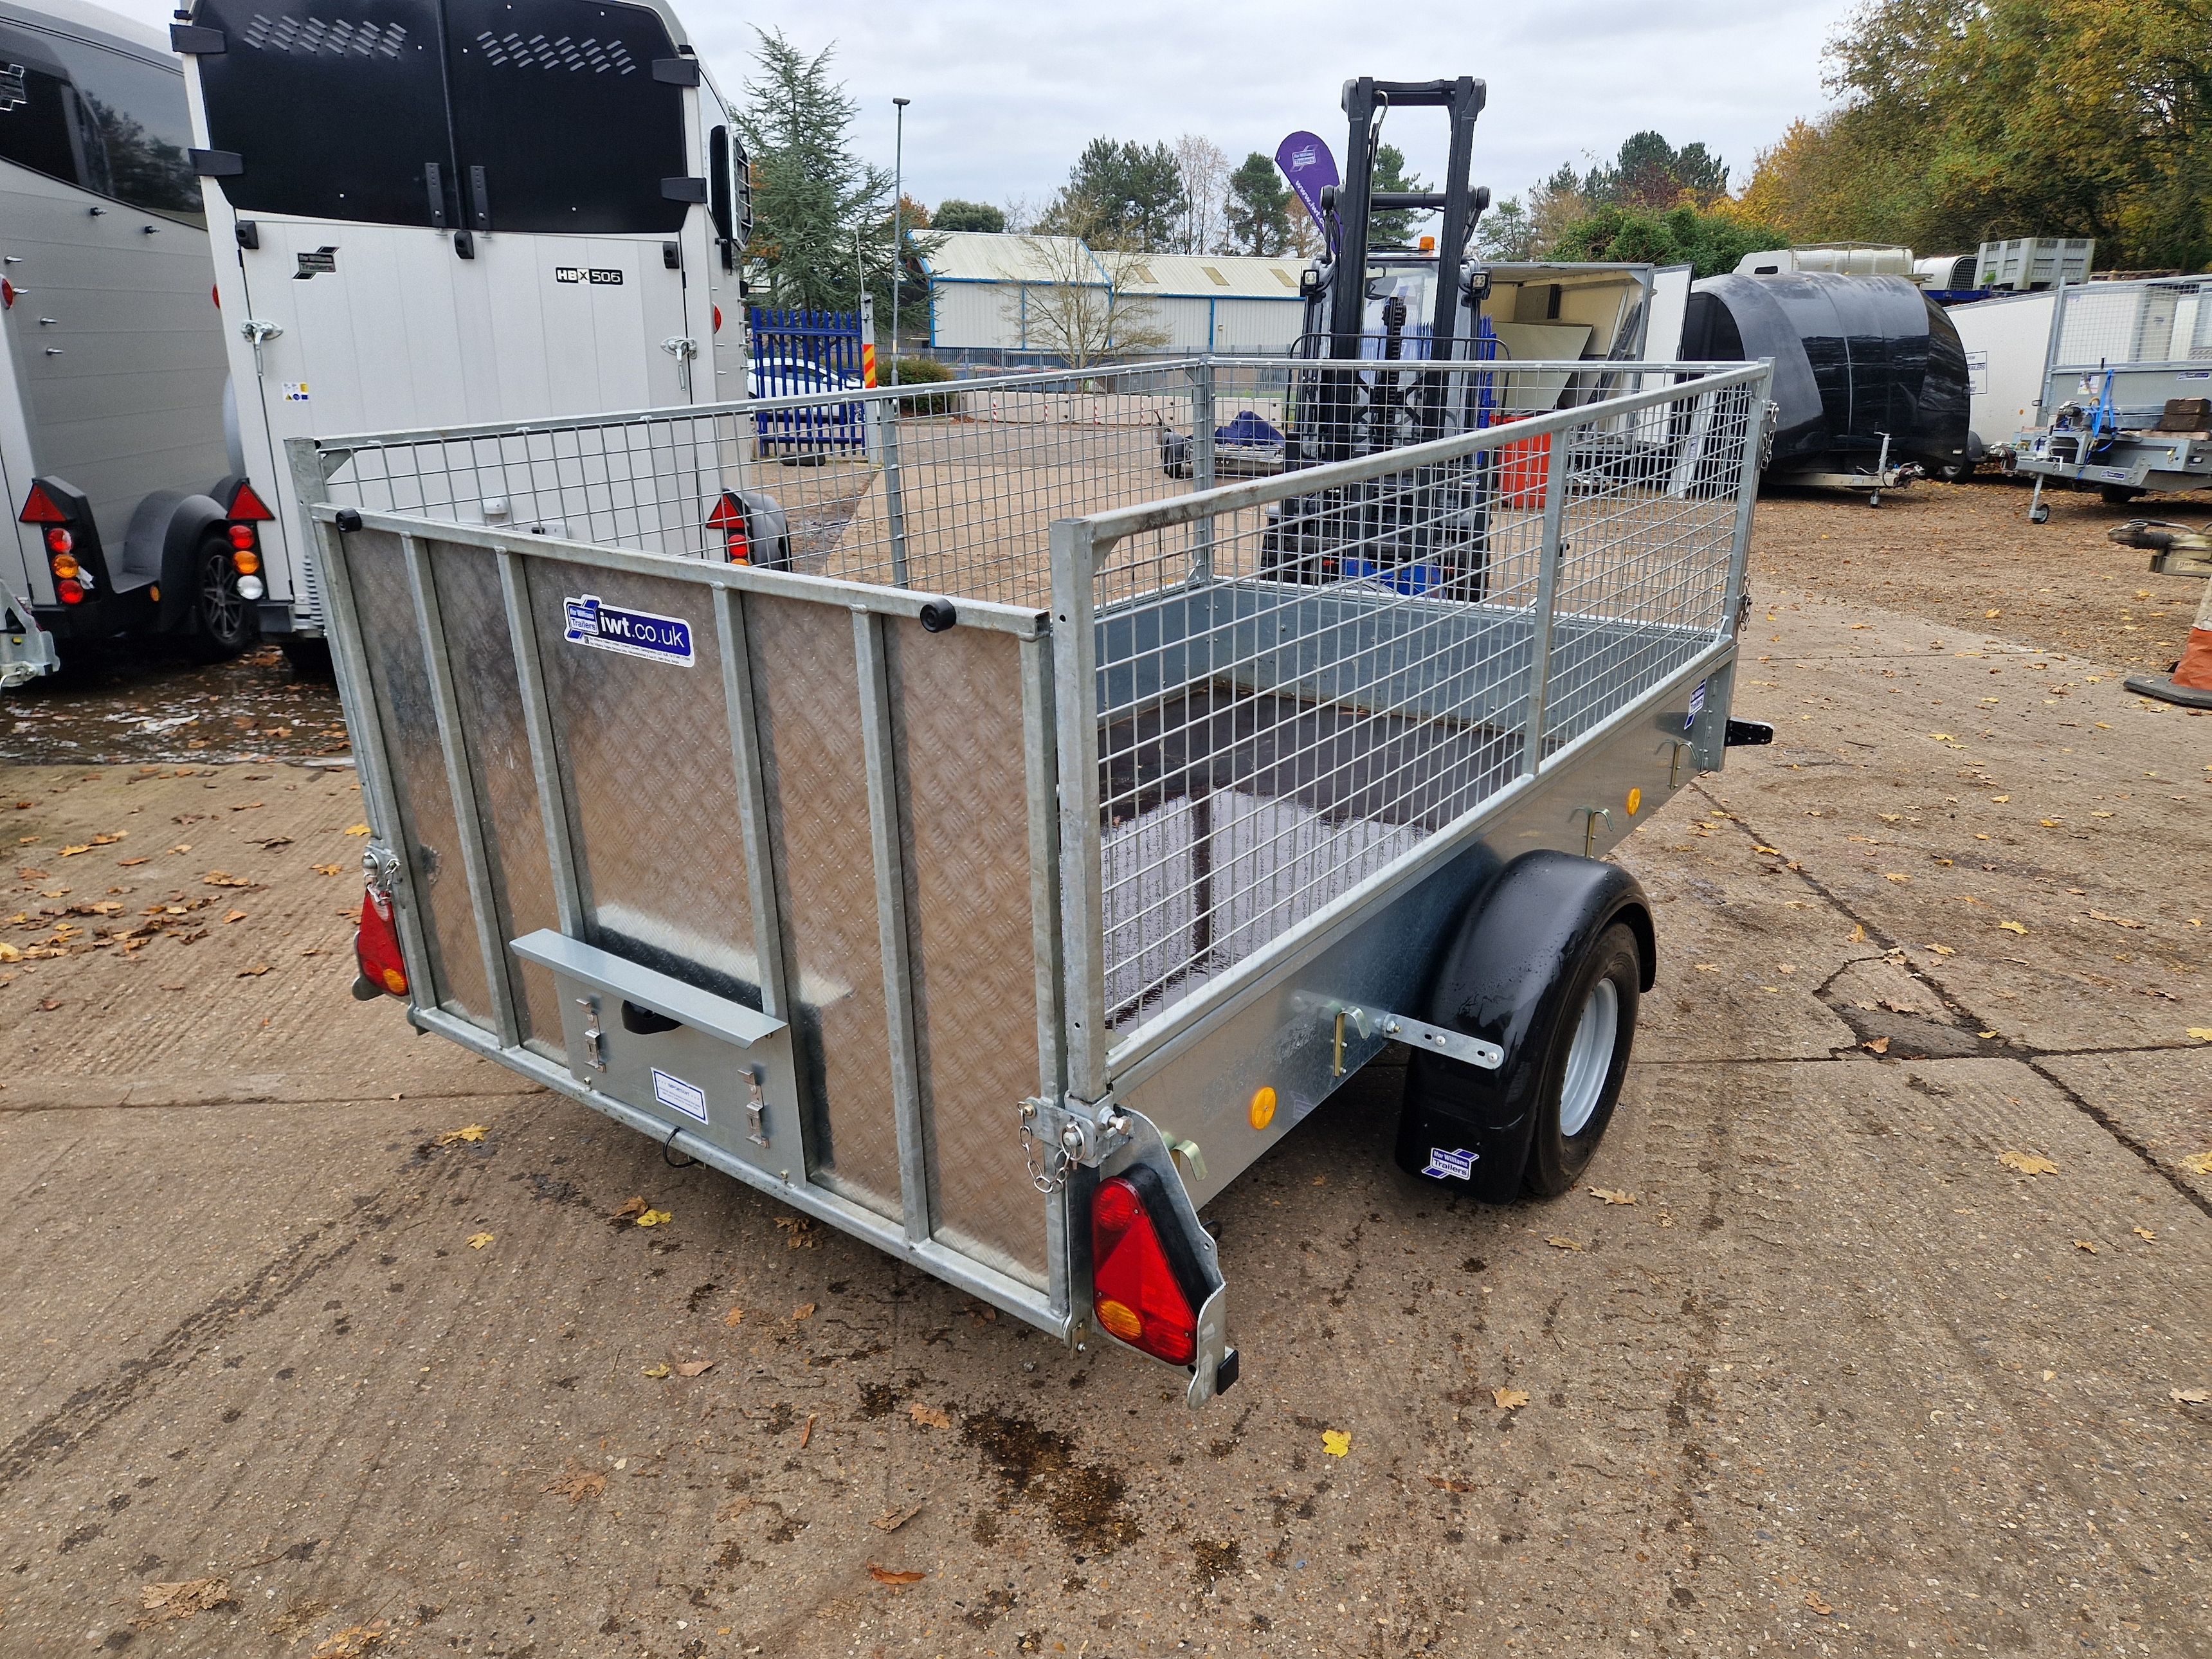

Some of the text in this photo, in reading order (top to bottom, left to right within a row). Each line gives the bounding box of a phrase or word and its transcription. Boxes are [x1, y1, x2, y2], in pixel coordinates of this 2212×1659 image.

[572, 619, 595, 630] Trailers
[600, 612, 685, 648] iwt.co.uk
[1434, 1159, 1467, 1175] Trailers
[1444, 1154, 1468, 1167] Williams
